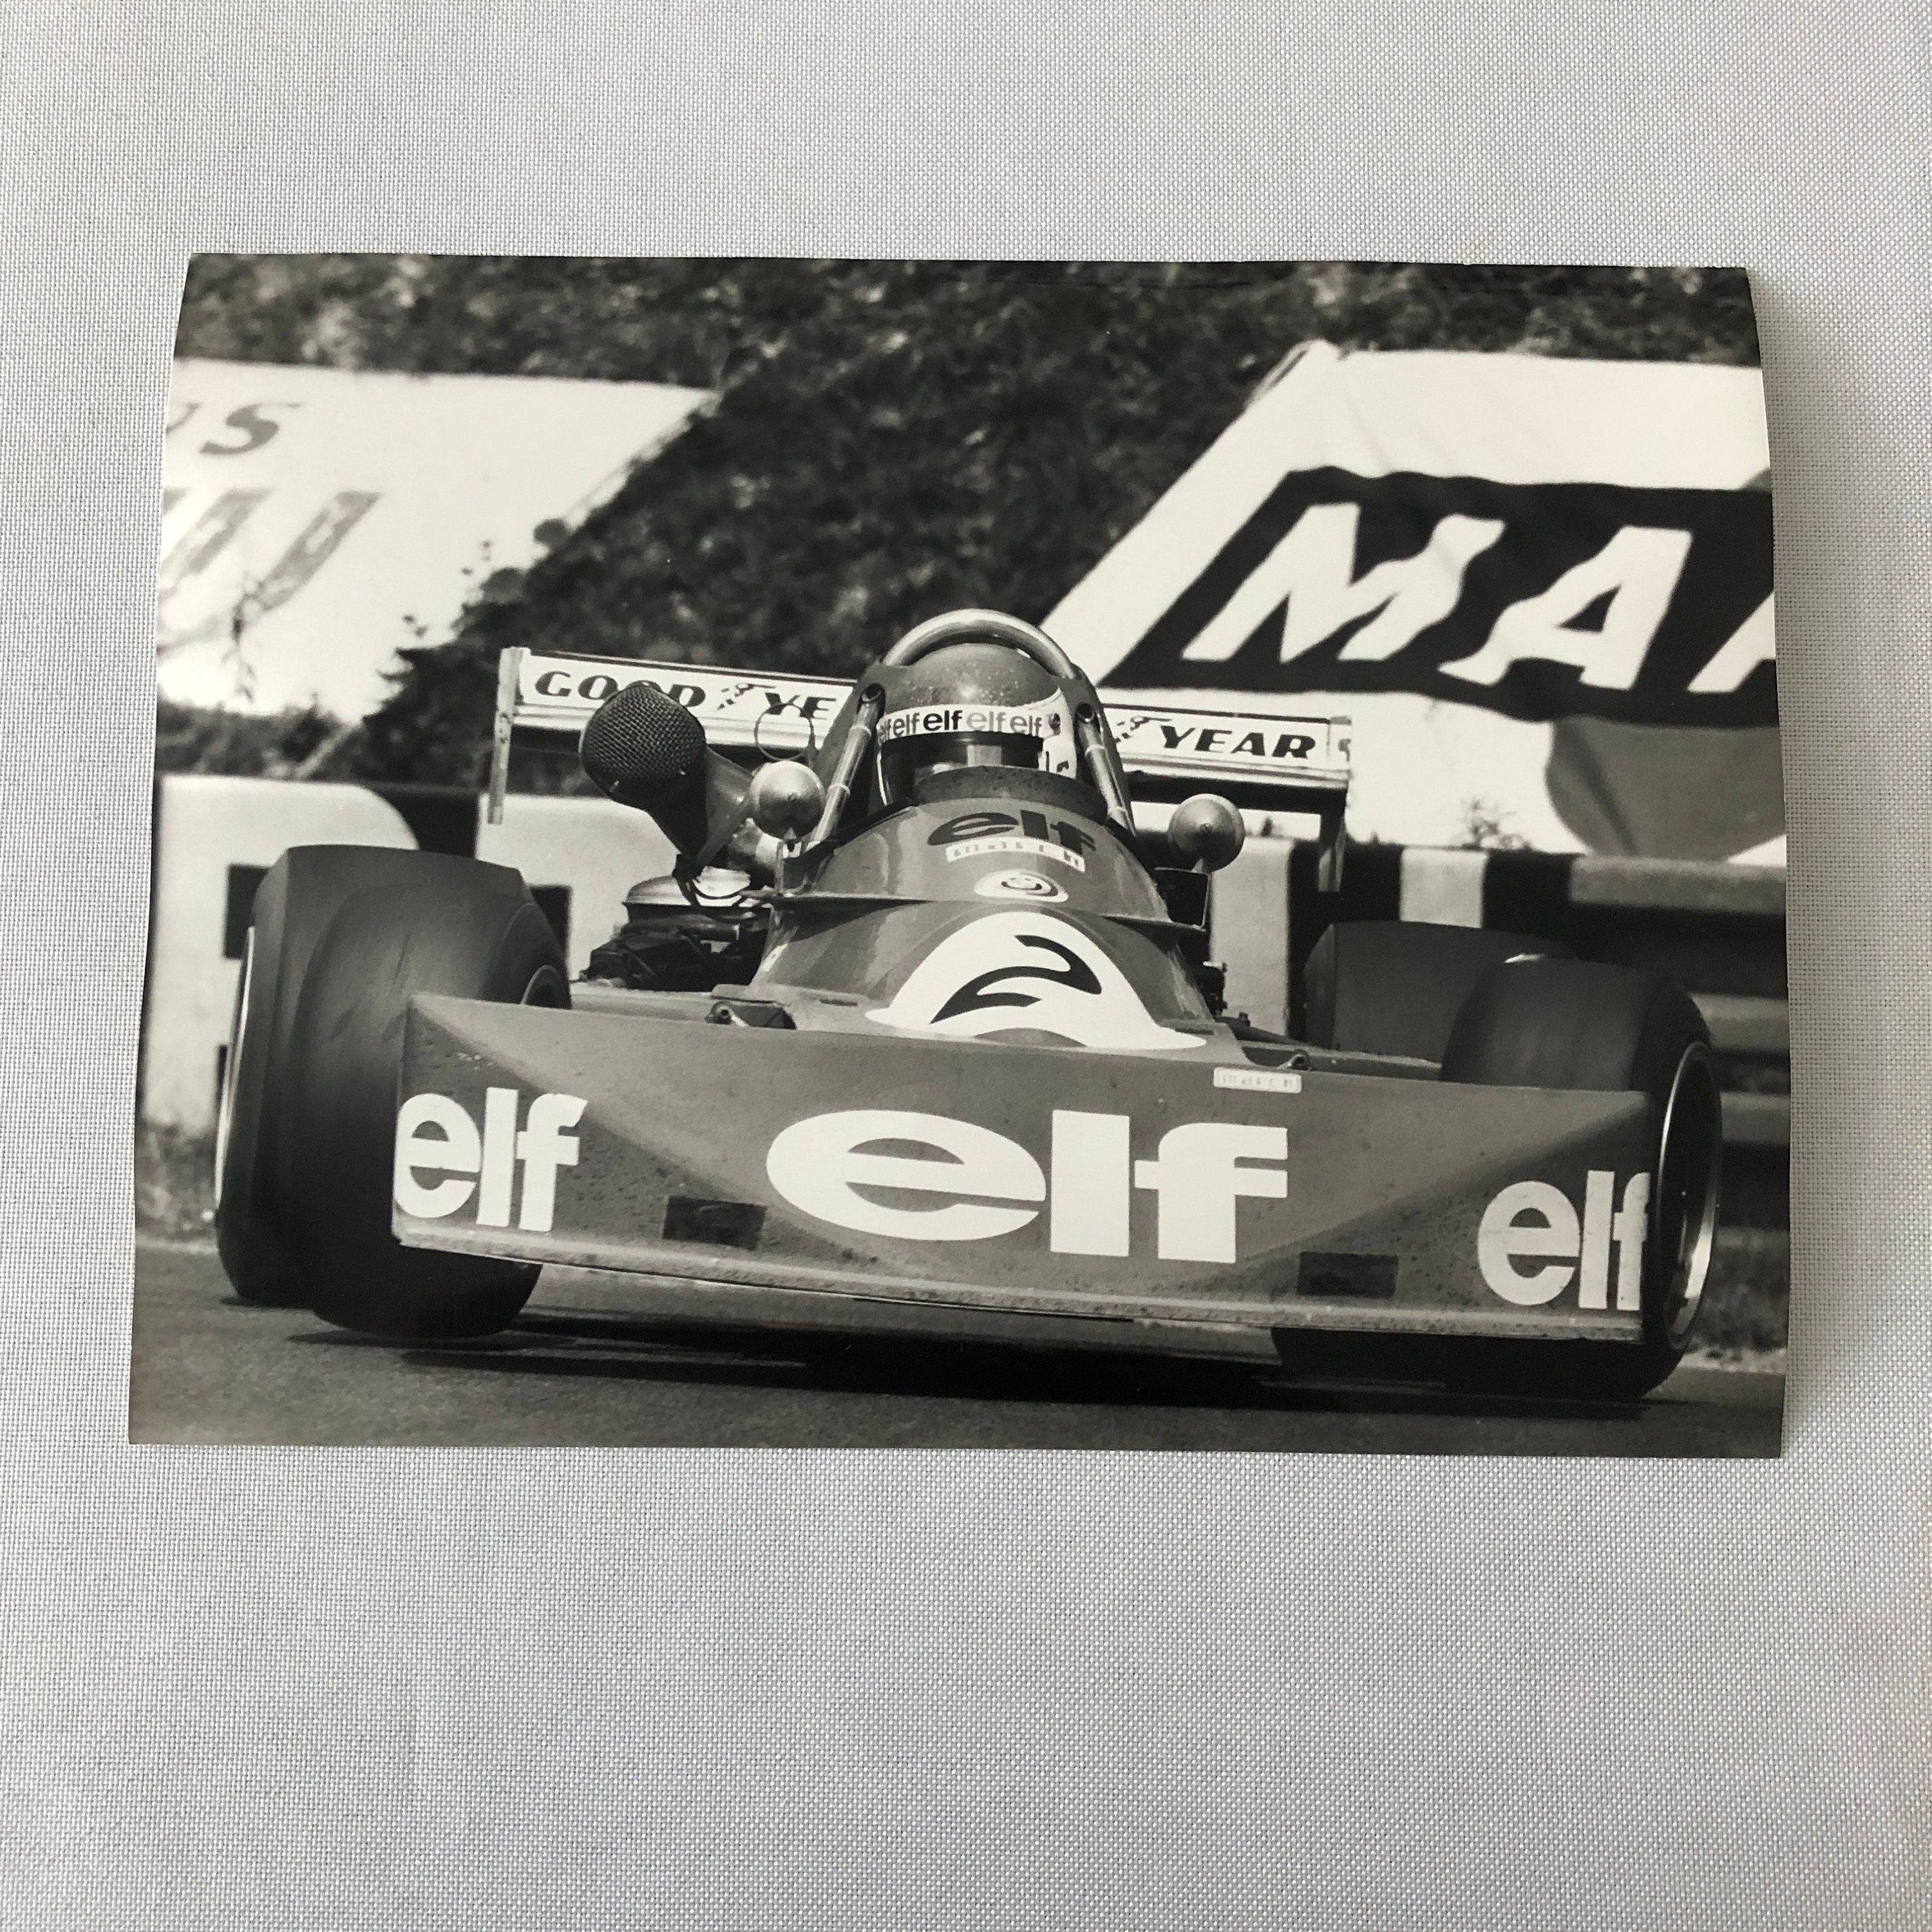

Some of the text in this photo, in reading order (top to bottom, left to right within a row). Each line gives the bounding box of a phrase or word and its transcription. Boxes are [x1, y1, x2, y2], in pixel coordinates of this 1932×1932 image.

[535, 671, 706, 708] GOD
[893, 712, 920, 737] elf
[923, 710, 963, 732] elf
[966, 711, 1007, 732] elf
[1009, 715, 1043, 737] elf
[1160, 724, 1316, 759] YEAR
[927, 809, 1097, 855] elf
[929, 934, 1103, 1025] 2
[393, 1086, 589, 1232] elf
[766, 1109, 1288, 1264] elf
[1477, 1170, 1651, 1311] elf
